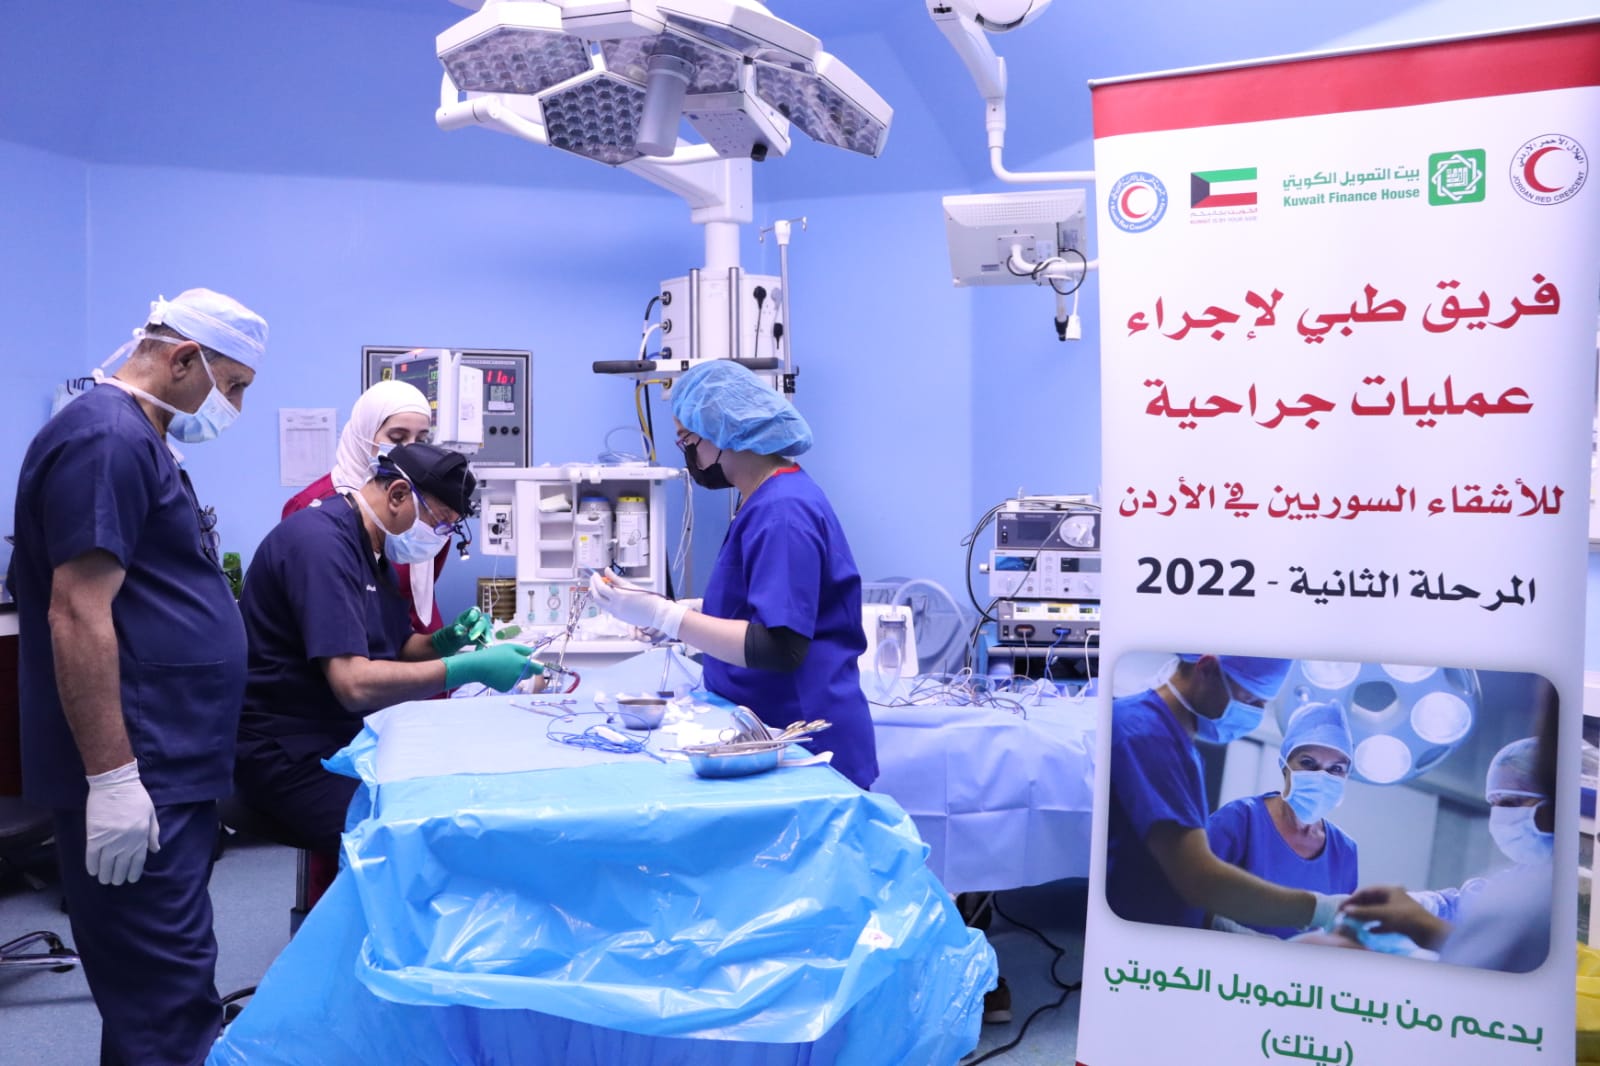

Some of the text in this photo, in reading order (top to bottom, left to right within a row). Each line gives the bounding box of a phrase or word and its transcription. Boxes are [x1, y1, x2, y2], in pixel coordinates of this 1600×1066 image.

[1283, 165, 1420, 192] بيت التمويل الكويتي
[1283, 188, 1420, 207] Kuwait Finance House
[1513, 171, 1585, 203] JORDAN RED CRESCENT
[1127, 272, 1561, 344] فريق طبي لإجراء
[1143, 375, 1534, 430] عمليات جراحية
[1118, 476, 1565, 521] للأشقاء السوريين في الأردن
[1136, 556, 1256, 598] 2022
[1288, 566, 1399, 605] الثانية
[1408, 569, 1537, 612] المرحلة
[1104, 959, 1544, 1052] بدعم من بيت التمويل الكويتي
